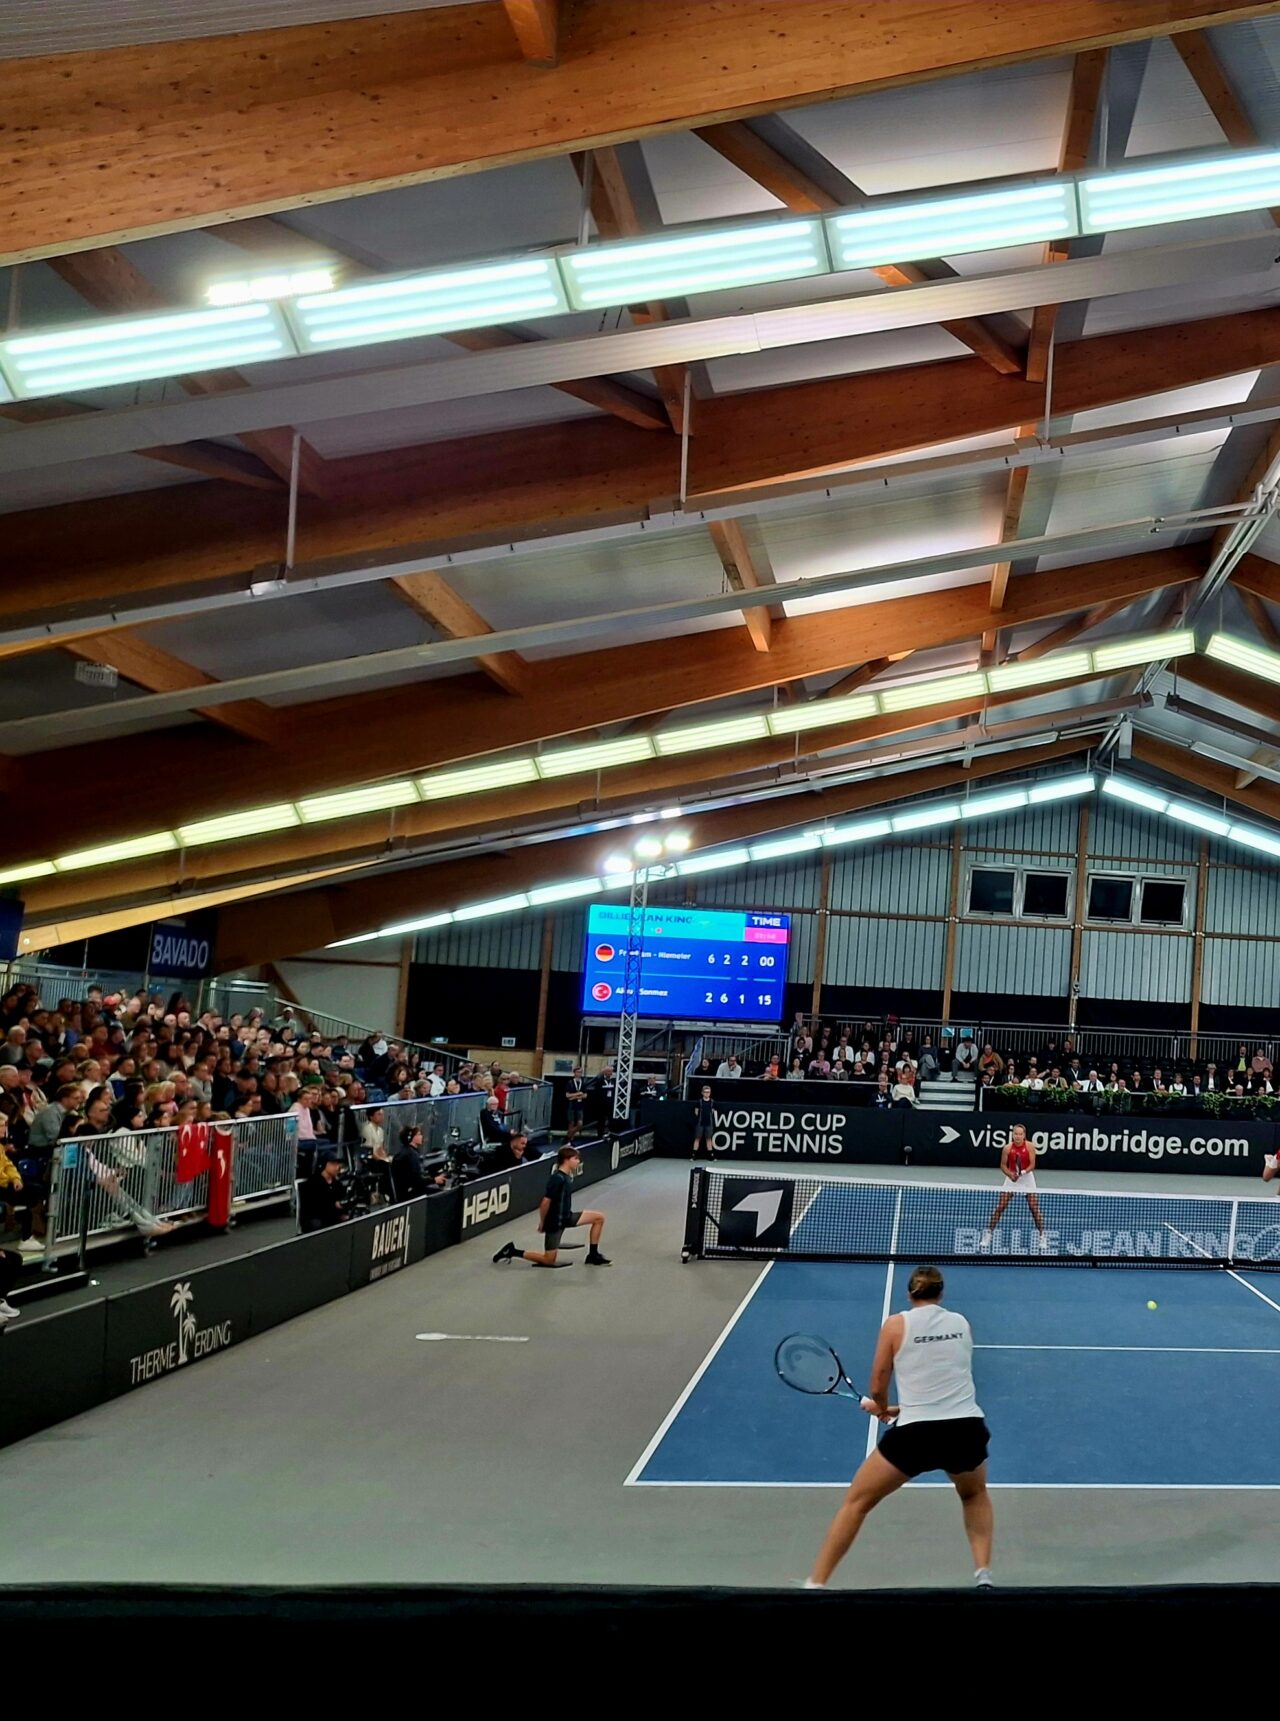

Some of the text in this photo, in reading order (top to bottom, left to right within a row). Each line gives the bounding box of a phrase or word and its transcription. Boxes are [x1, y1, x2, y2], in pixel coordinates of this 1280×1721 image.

[752, 916, 781, 926] TIME
[151, 934, 209, 968] BAVADO
[708, 954, 715, 964] 6
[723, 954, 731, 965] 2
[741, 955, 748, 966] 2
[759, 956, 775, 967] 00
[705, 993, 712, 1003] 2
[720, 993, 728, 1003] 6
[739, 995, 745, 1004] 1
[758, 995, 771, 1006] 15
[713, 1110, 846, 1131] WORLD CUP
[712, 1131, 843, 1154] OF TENNIS
[969, 1124, 1249, 1160] visi gainbridge.com
[462, 1184, 510, 1229] HEAD
[955, 1228, 1059, 1256] BILLIE
[1067, 1231, 1161, 1257] JEAN
[1169, 1232, 1252, 1258] KING
[130, 1319, 231, 1385] THERME ERDING
